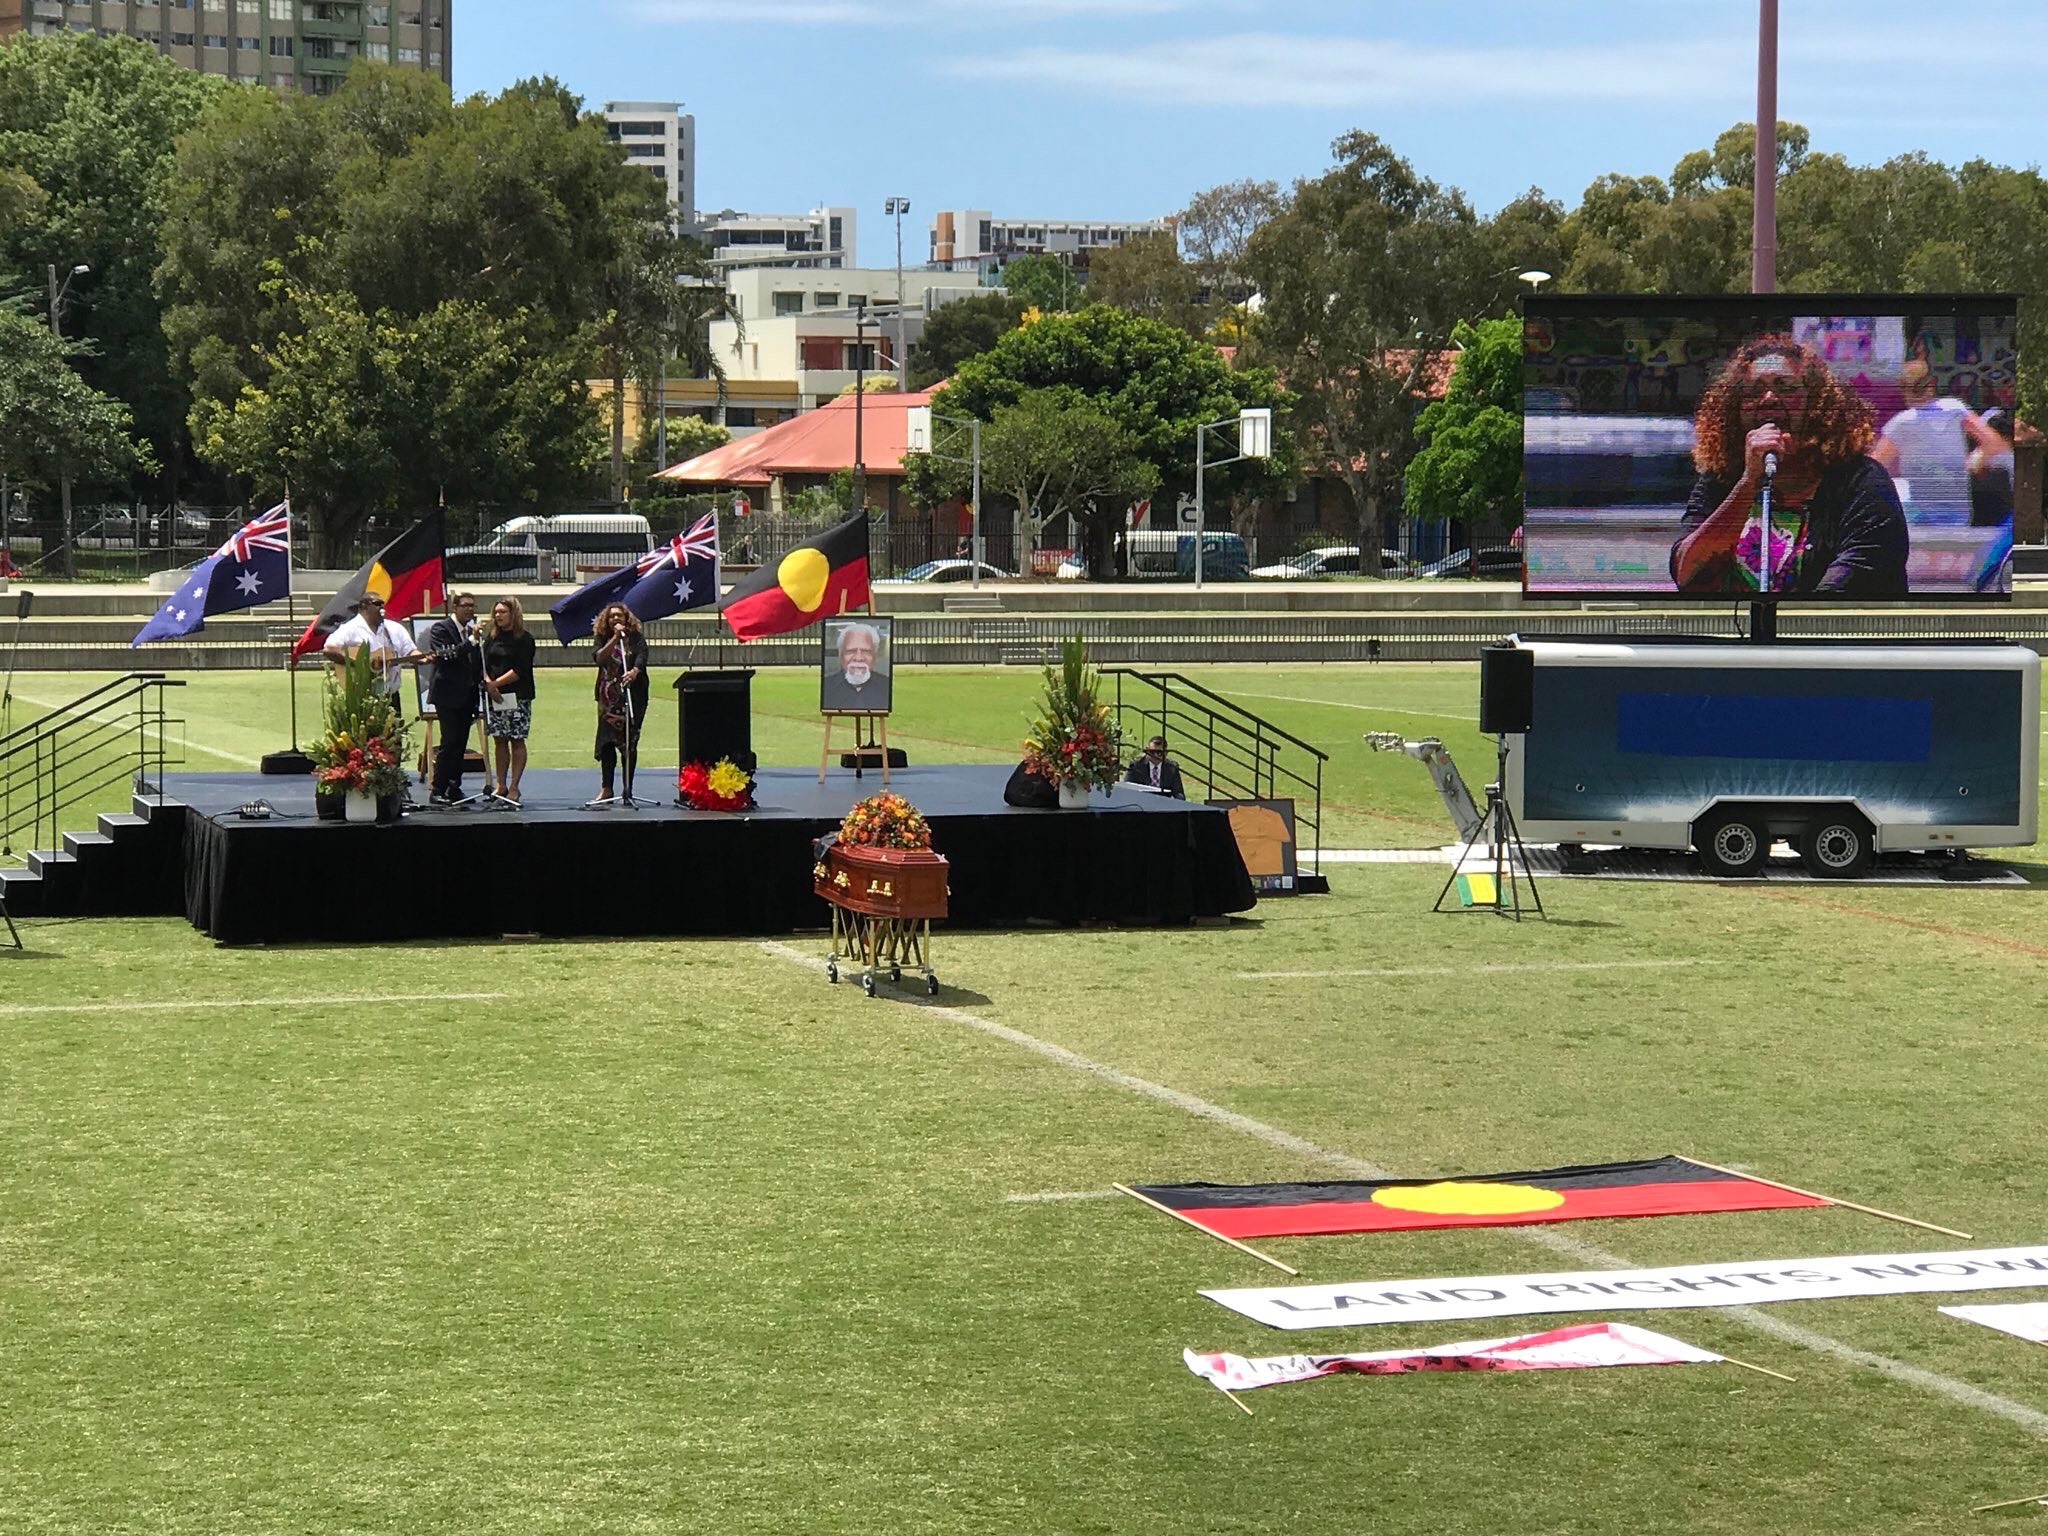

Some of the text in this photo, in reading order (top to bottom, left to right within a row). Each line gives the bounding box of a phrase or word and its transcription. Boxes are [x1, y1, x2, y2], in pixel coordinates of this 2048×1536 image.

[1269, 1257, 2048, 1312] LAND RIGHTS NOW
